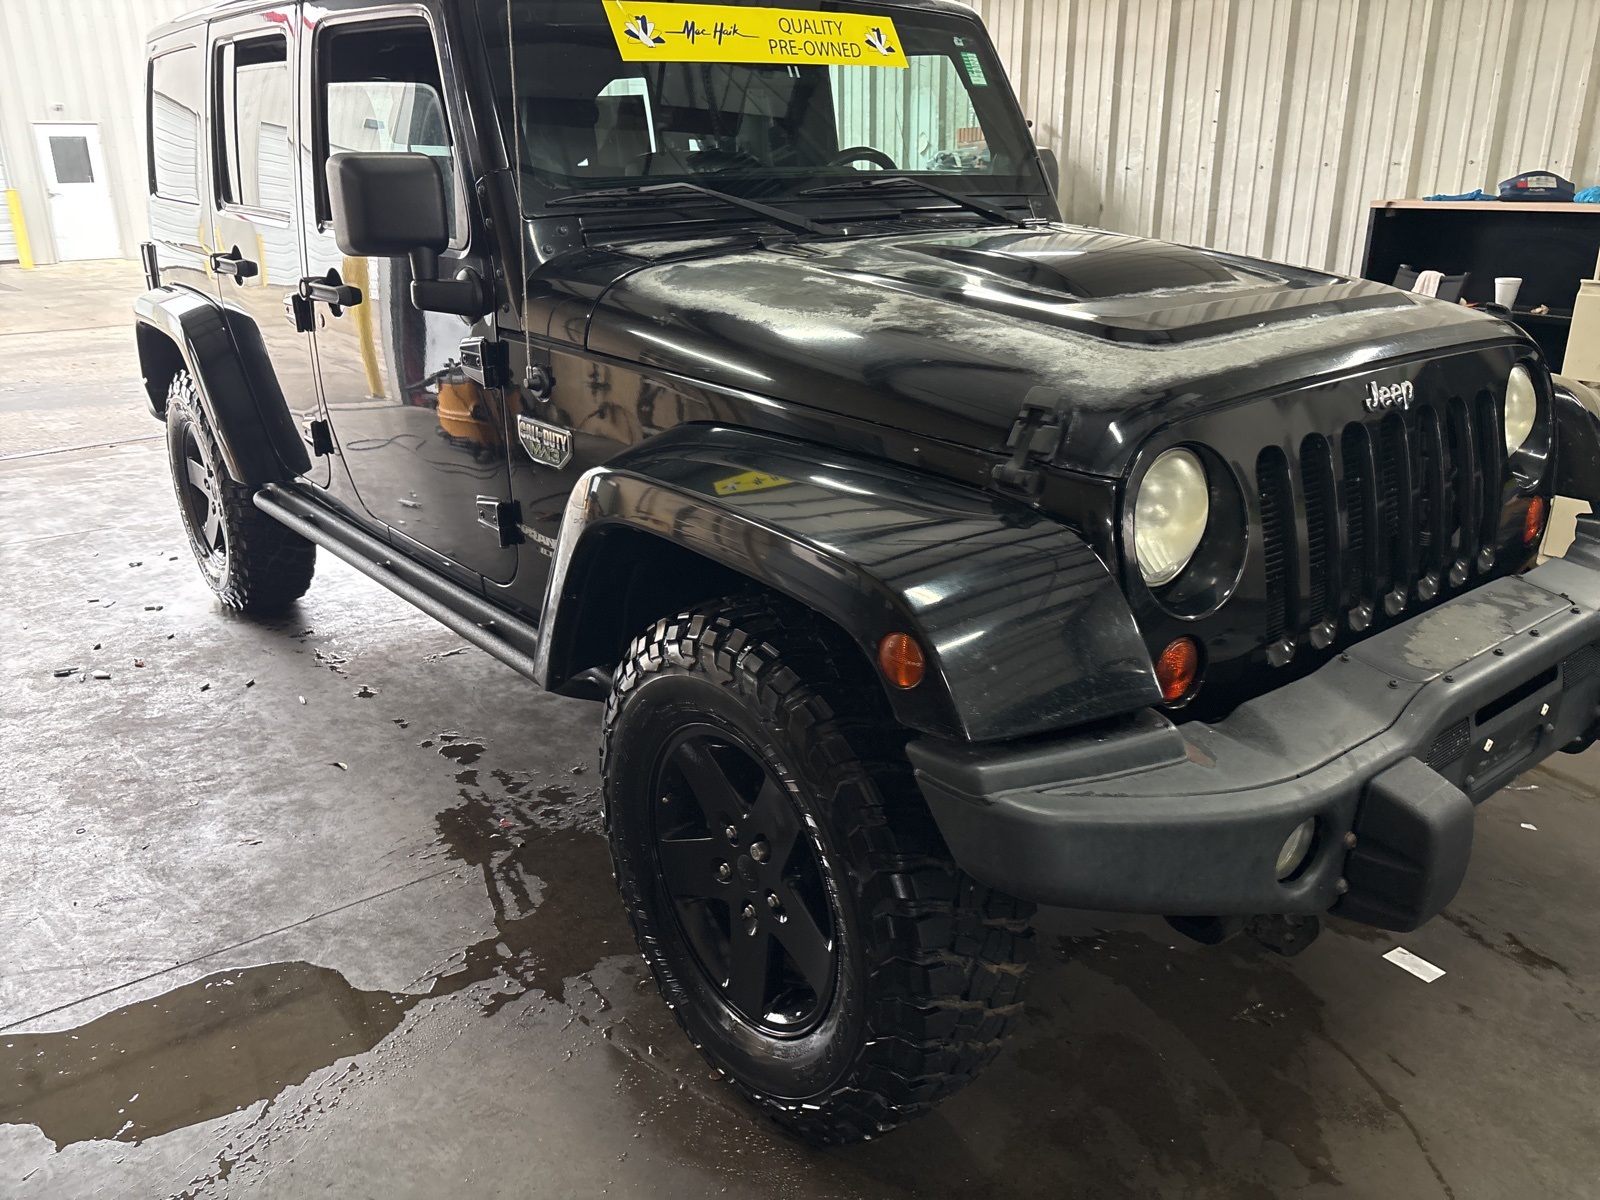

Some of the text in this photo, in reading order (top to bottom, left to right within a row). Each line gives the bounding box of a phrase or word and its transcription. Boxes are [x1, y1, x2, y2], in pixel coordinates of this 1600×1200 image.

[665, 19, 759, 46] Mac Haik
[778, 17, 842, 36] QUALITY
[768, 38, 861, 58] PRE-OWNED
[1365, 380, 1414, 411] Jeep
[520, 421, 541, 443] CALL
[543, 429, 567, 451] DUTY
